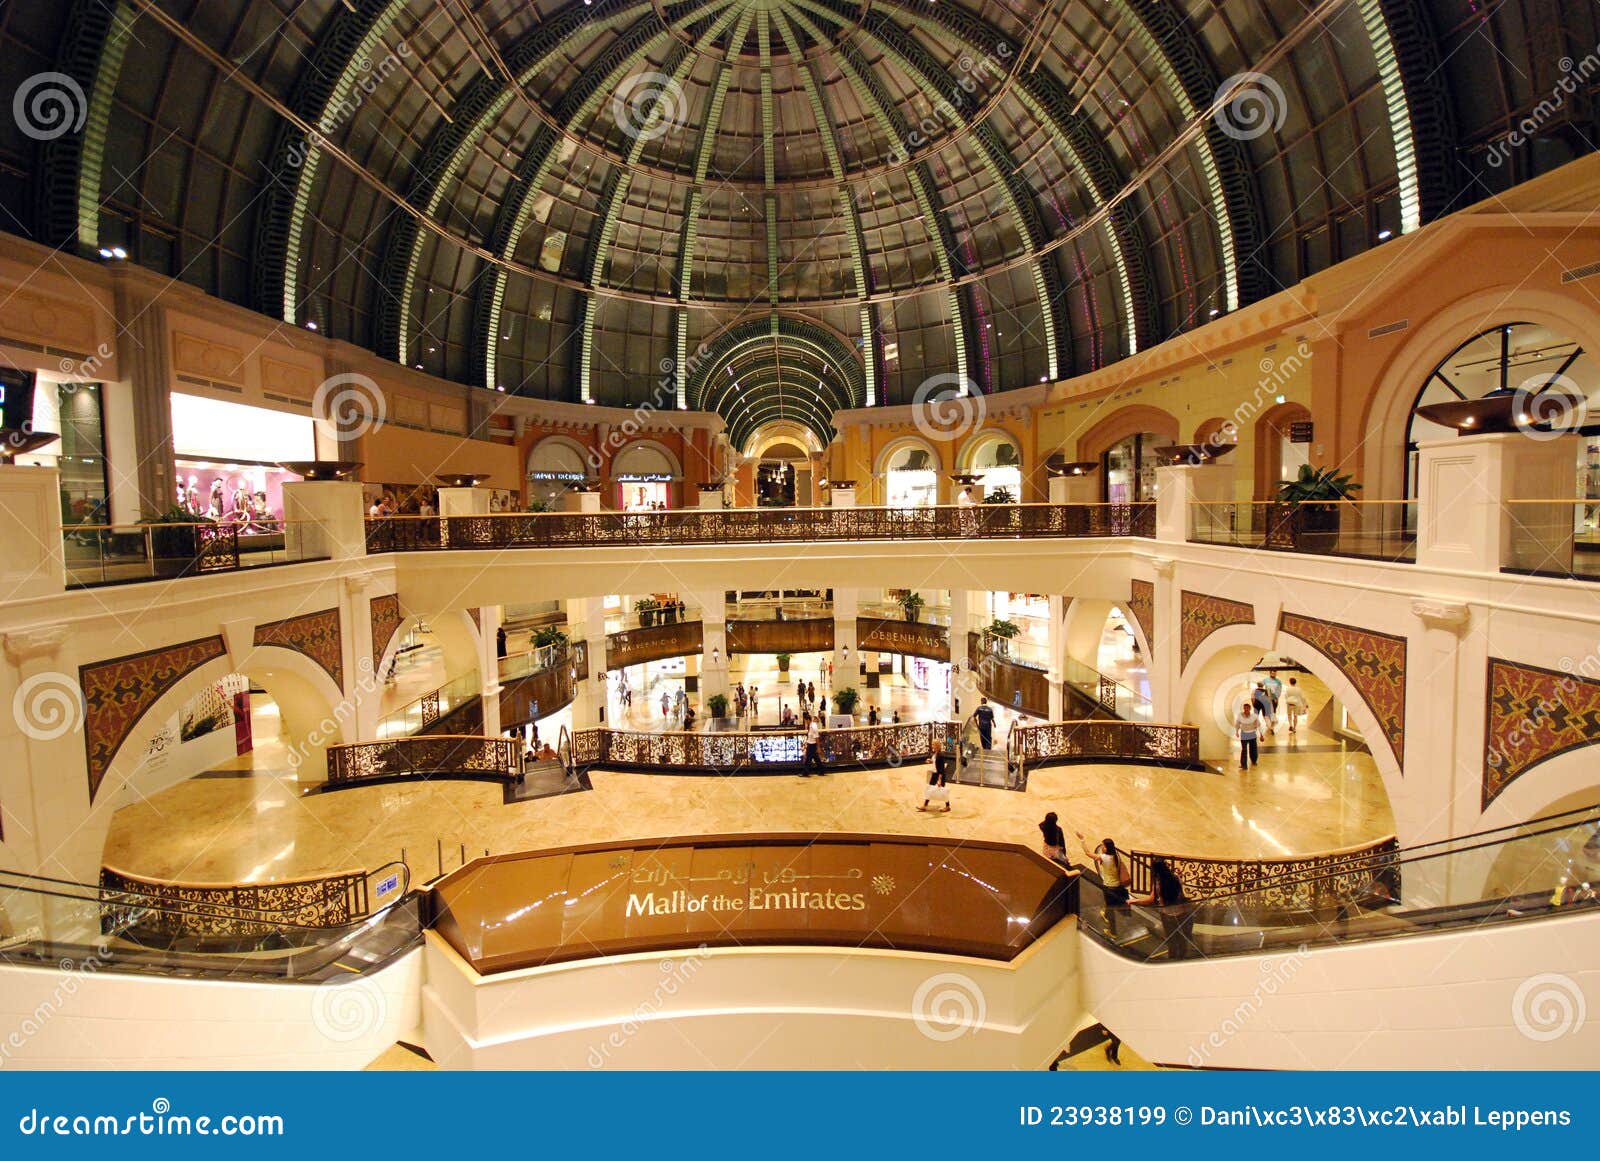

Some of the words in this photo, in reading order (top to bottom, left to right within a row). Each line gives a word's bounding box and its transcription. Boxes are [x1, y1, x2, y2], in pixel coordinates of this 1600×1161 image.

[871, 631, 940, 648] DEBENHAMS
[625, 890, 686, 918] Mall
[687, 895, 709, 912] of
[712, 894, 744, 911] the
[749, 887, 865, 911] Emirates
